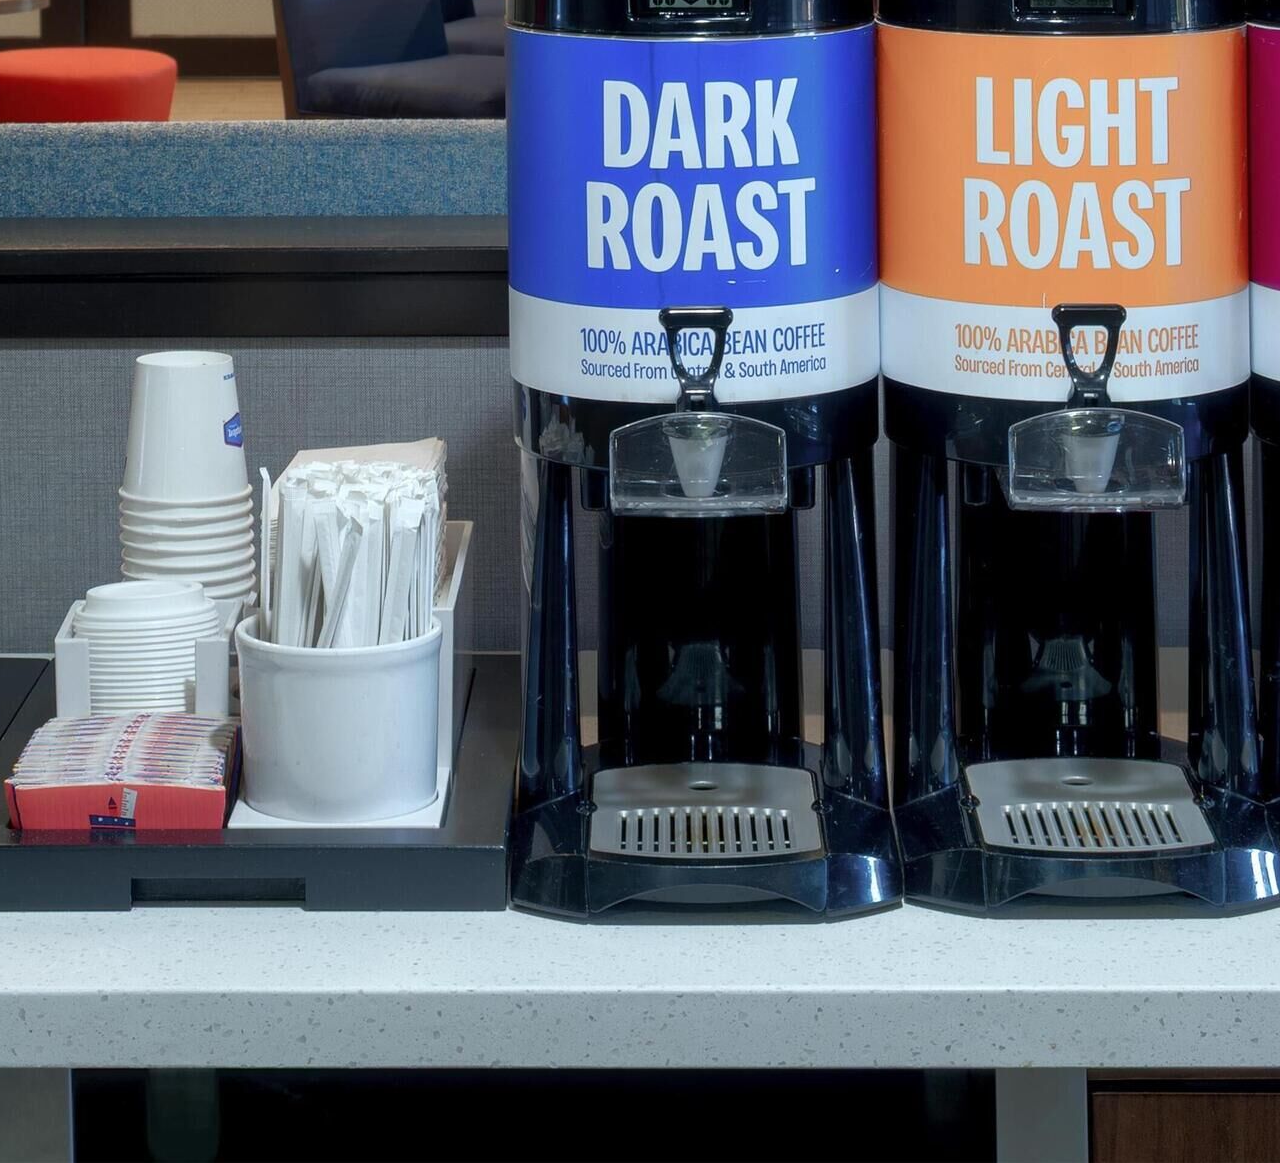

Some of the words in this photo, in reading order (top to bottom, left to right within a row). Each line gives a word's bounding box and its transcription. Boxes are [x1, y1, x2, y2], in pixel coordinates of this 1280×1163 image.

[603, 77, 800, 170] DARK
[975, 76, 1179, 168] LIGHT
[585, 176, 817, 273] ROAST
[963, 177, 1191, 270] ROAST
[580, 327, 627, 355] 100%
[723, 328, 768, 356] BEAN
[773, 322, 826, 352] COFFEE
[580, 358, 631, 379] Sourced
[634, 361, 668, 380] From
[724, 362, 736, 379] &
[738, 359, 778, 378] South
[780, 355, 827, 376] America
[955, 323, 1002, 351] 100%
[1006, 328, 1089, 355] ARABA
[1094, 328, 1143, 355] BAN
[1148, 324, 1200, 353] COFFEE
[955, 354, 1006, 375] Sourced
[1008, 359, 1042, 378] From
[1114, 360, 1152, 378] South
[1154, 357, 1200, 376] America
